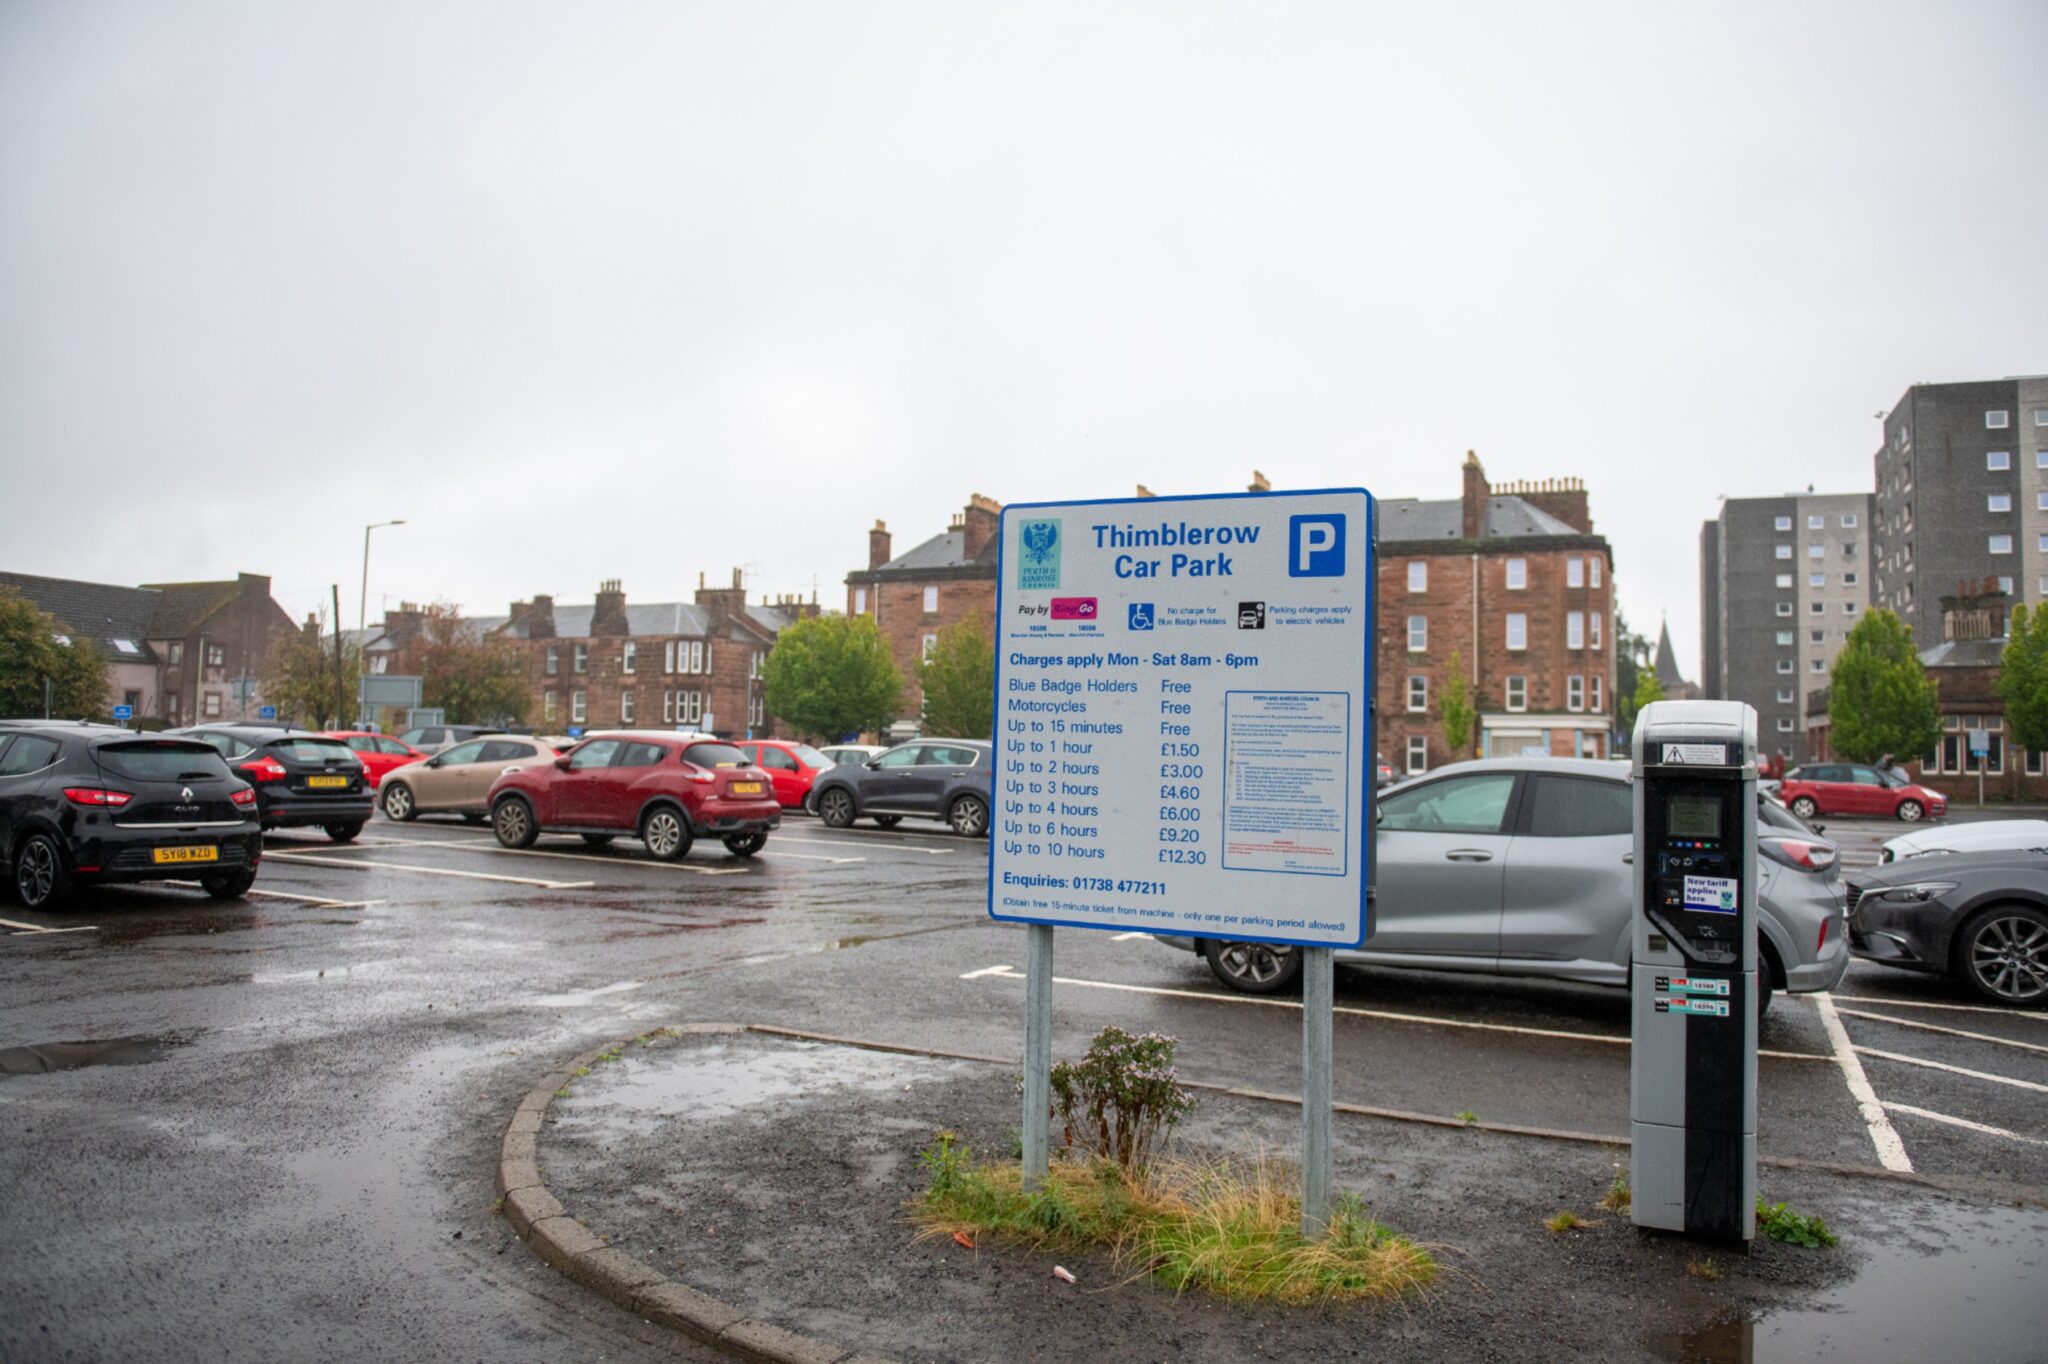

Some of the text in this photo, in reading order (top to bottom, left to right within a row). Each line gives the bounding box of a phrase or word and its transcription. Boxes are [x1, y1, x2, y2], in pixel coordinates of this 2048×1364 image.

[1092, 522, 1260, 548] Thimblerow
[1299, 522, 1336, 571] P
[1023, 567, 1048, 575] PERTH
[1114, 553, 1233, 579] Car Park
[1022, 575, 1056, 583] KINROSS
[1018, 605, 1036, 616] Pay
[1037, 605, 1049, 616] by
[1167, 606, 1216, 617] No charge for
[1269, 606, 1352, 616] Parking charges apply
[1158, 617, 1227, 627] Blue Badge Holders
[1286, 617, 1312, 625] electric
[1315, 617, 1345, 625] vehicles
[1009, 653, 1063, 669] Charges
[1067, 653, 1104, 669] apply
[1107, 653, 1139, 667] Mon
[1152, 653, 1177, 667] Sat
[1180, 653, 1212, 667] 8am
[1225, 653, 1259, 669] 6pm
[1009, 679, 1192, 695] Blue Badge Holders Free
[1008, 699, 1191, 715] Motorcycles Free
[1008, 719, 1191, 736] Up to 15 minutes Free
[1007, 739, 1200, 757] Up to 1 hour £1.50
[1007, 759, 1203, 778] Up to 2 hours £3.00
[1006, 779, 1200, 800] Up to 3 hours £4.60
[1005, 799, 1200, 821] Up to 4 hours £6.00
[1005, 820, 1199, 843] Up to 6 hours £9.20
[162, 847, 211, 860] SY18 WZD
[1004, 840, 1206, 865] Up to 10 hours £12.30
[1004, 871, 1166, 895] Enquiries: 01738 477211
[1687, 887, 1717, 895] applies
[1033, 899, 1048, 909] free
[1051, 900, 1090, 912] 15-minute
[1093, 905, 1114, 914] ticket
[1117, 906, 1137, 915] from
[1140, 909, 1175, 918] machine
[1184, 911, 1201, 921] only
[1205, 914, 1221, 922] one
[1224, 915, 1239, 924] per
[1242, 916, 1274, 927] parking
[1277, 919, 1305, 928] period
